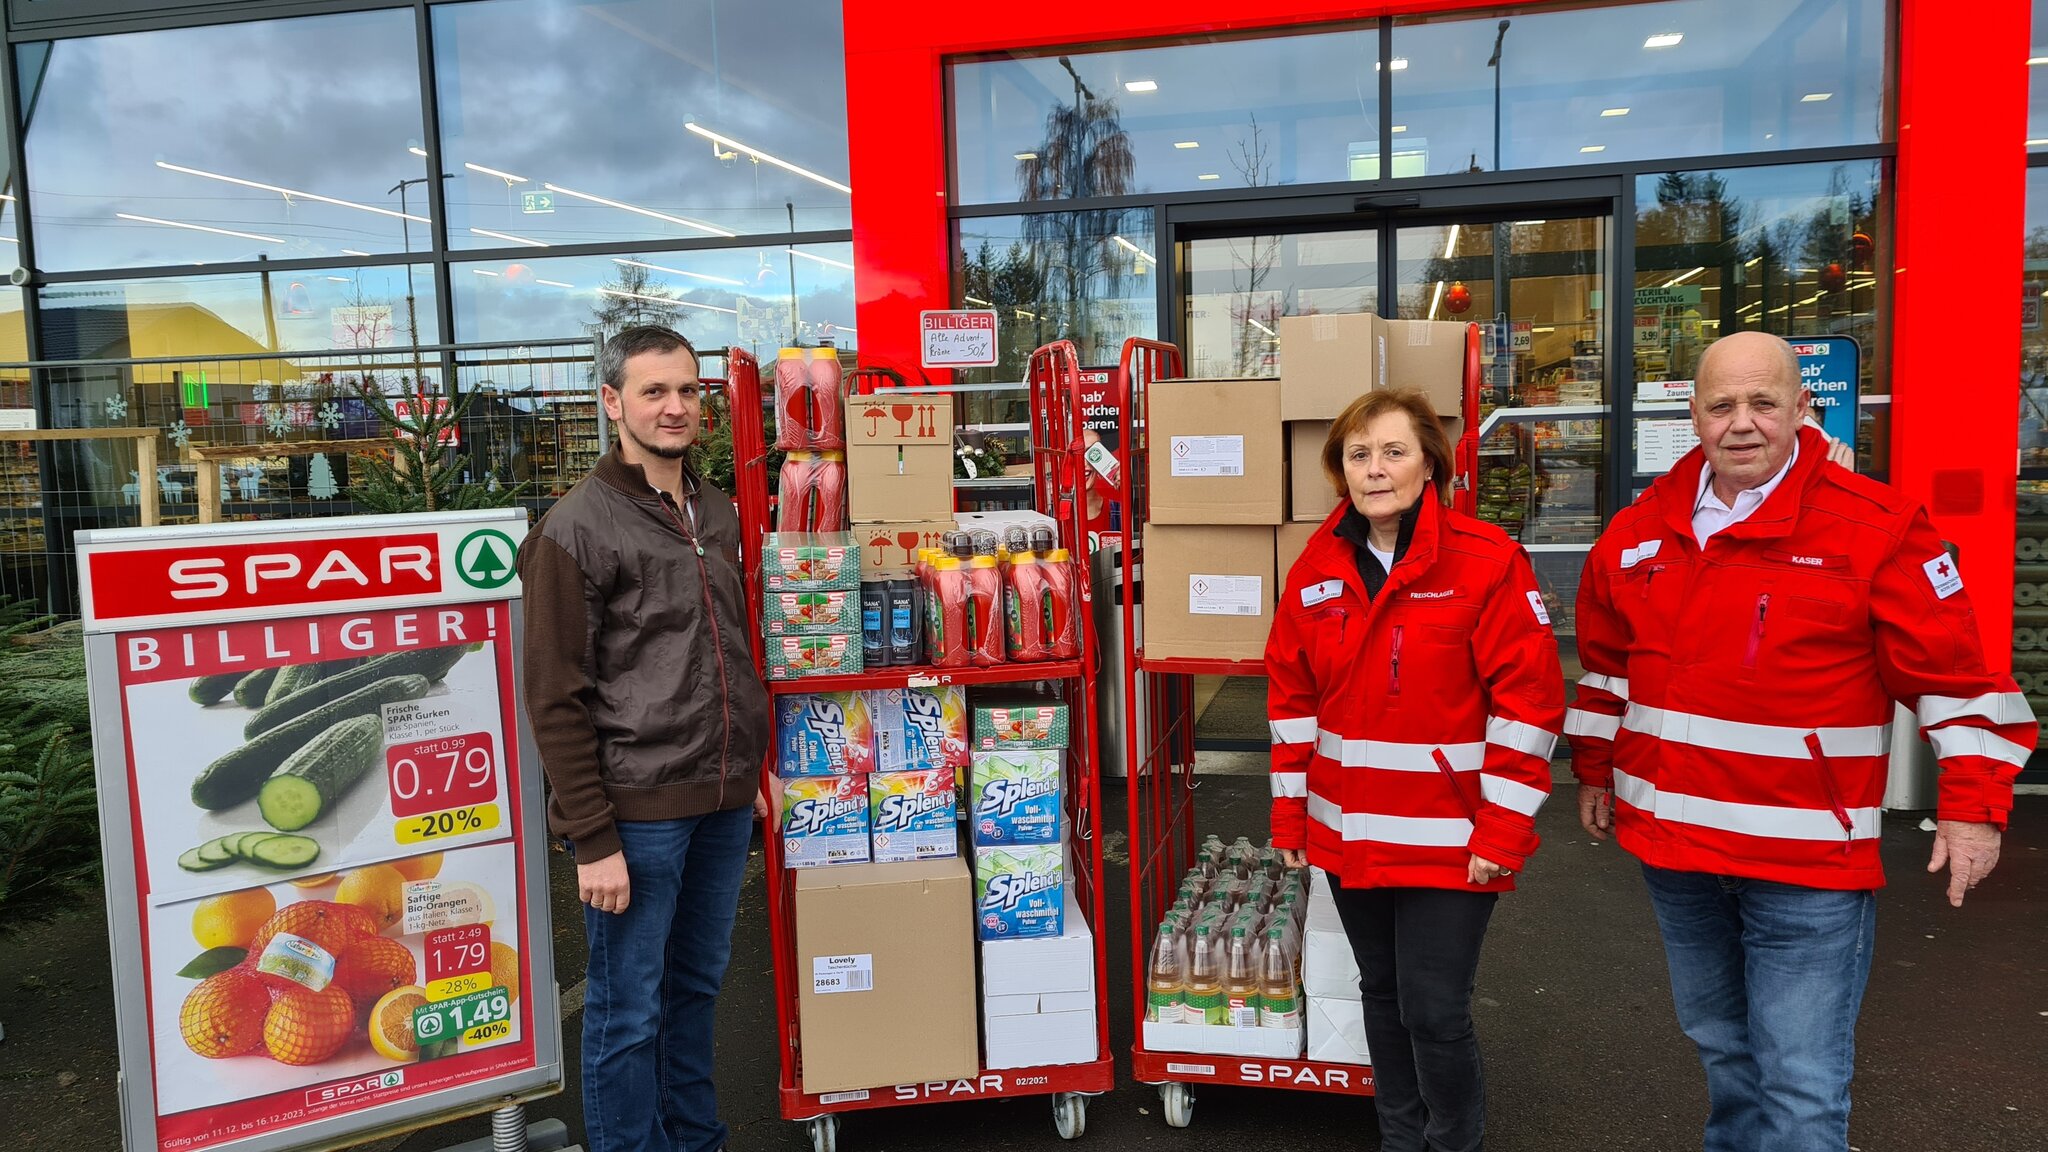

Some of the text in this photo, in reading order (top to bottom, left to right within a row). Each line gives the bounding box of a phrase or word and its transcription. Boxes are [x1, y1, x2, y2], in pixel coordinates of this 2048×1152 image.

[924, 317, 993, 329] BILLIGER!
[931, 333, 984, 343] Alle Advent-
[1514, 336, 1530, 346] 2,69
[1641, 331, 1658, 341] 3,99
[960, 342, 988, 357] -50%
[1800, 363, 1825, 377] ab'
[1791, 555, 1823, 566] KASER
[168, 545, 433, 600] SPAR
[1410, 590, 1454, 599] FREISCHLAGER
[127, 607, 497, 672] BILLIGER!
[386, 704, 420, 715] Frische
[387, 709, 450, 724] SPAR Gurken
[388, 720, 437, 732] aus Spanien,
[389, 731, 413, 740] Klasse
[424, 727, 437, 737] per
[439, 723, 460, 733] Stück
[414, 738, 466, 755] statt 0.99
[392, 747, 491, 799] 0.79
[1025, 805, 1042, 814] Voll-
[411, 807, 481, 838] -20%
[1011, 814, 1055, 824] waschmittel
[407, 893, 441, 904] Saftige
[407, 898, 467, 913] Bio-Orangen
[1029, 899, 1046, 908] Voll-
[408, 914, 421, 922] aus
[422, 910, 448, 920] Italien,
[450, 906, 473, 916] Klasse
[1015, 908, 1059, 918] waschmittel
[409, 919, 446, 932] 1-kg-Netz
[432, 928, 482, 945] statt 2.49
[432, 942, 486, 973] 1.79
[440, 977, 477, 995] -28%
[815, 978, 841, 987] 28683
[415, 988, 506, 1015] Mit SPAR-App-Gutschein:
[449, 995, 508, 1030] 1.49
[468, 1022, 507, 1041] -40%
[1240, 1063, 1349, 1088] SPAR
[321, 1078, 380, 1101] SPAR
[895, 1074, 1049, 1100] SPAR 02/2021
[164, 1136, 191, 1149] Gültig
[193, 1132, 210, 1142] von
[212, 1125, 239, 1137] 11.12.
[241, 1121, 254, 1131] bis
[256, 1109, 306, 1127] 16.12.2023,
[307, 1105, 328, 1115] solange
